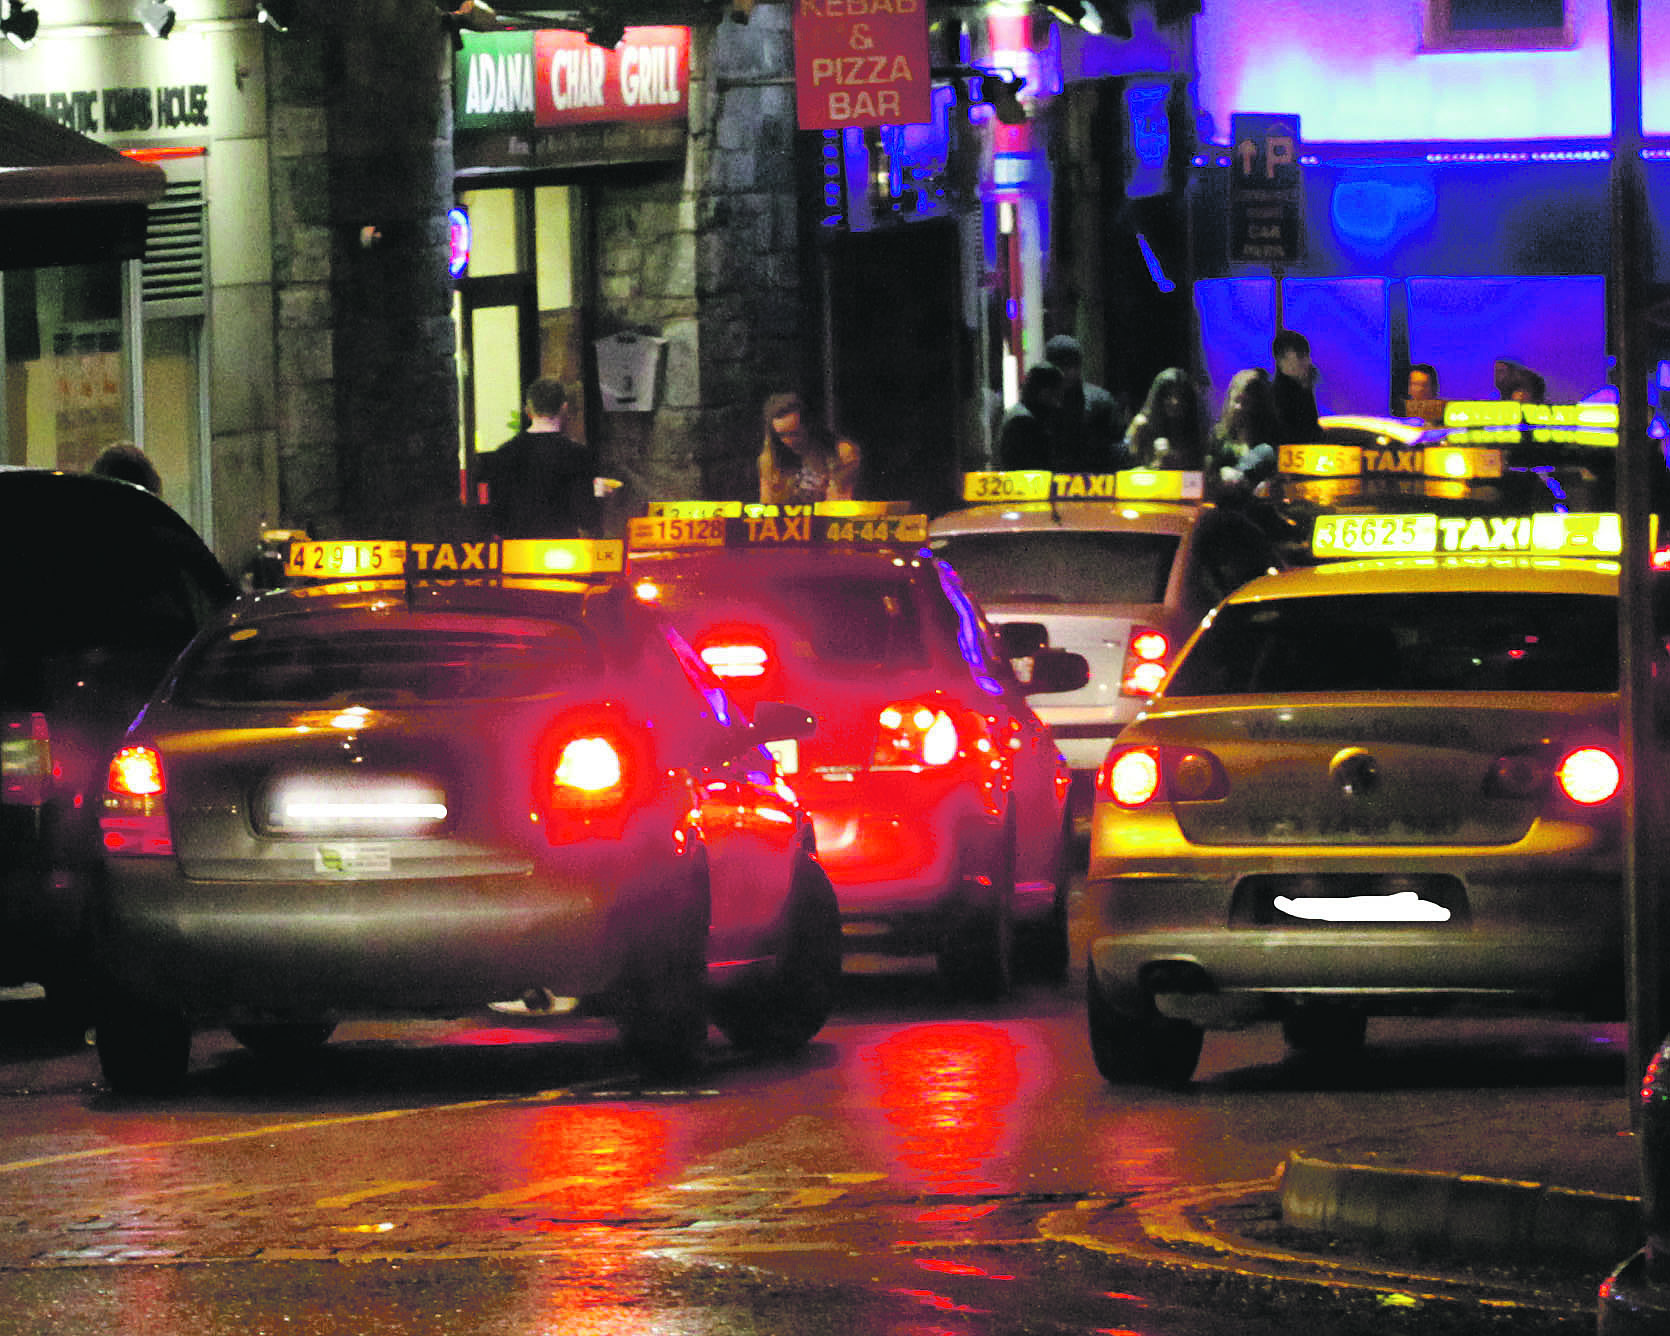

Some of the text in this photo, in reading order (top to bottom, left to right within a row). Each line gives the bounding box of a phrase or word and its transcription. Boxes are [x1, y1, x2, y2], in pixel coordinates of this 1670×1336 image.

[849, 23, 874, 49] &
[465, 46, 681, 114] ADANA CHAR GRILL
[812, 55, 913, 87] PIZZA
[829, 91, 900, 120] BAR
[1266, 137, 1293, 178] P
[1363, 450, 1424, 472] TAXI
[1053, 474, 1115, 497] TAXI
[744, 516, 812, 542] TAXI
[1319, 517, 1531, 551] 36625 TAXI
[294, 545, 383, 570] 42915
[411, 542, 499, 570] TAXI
